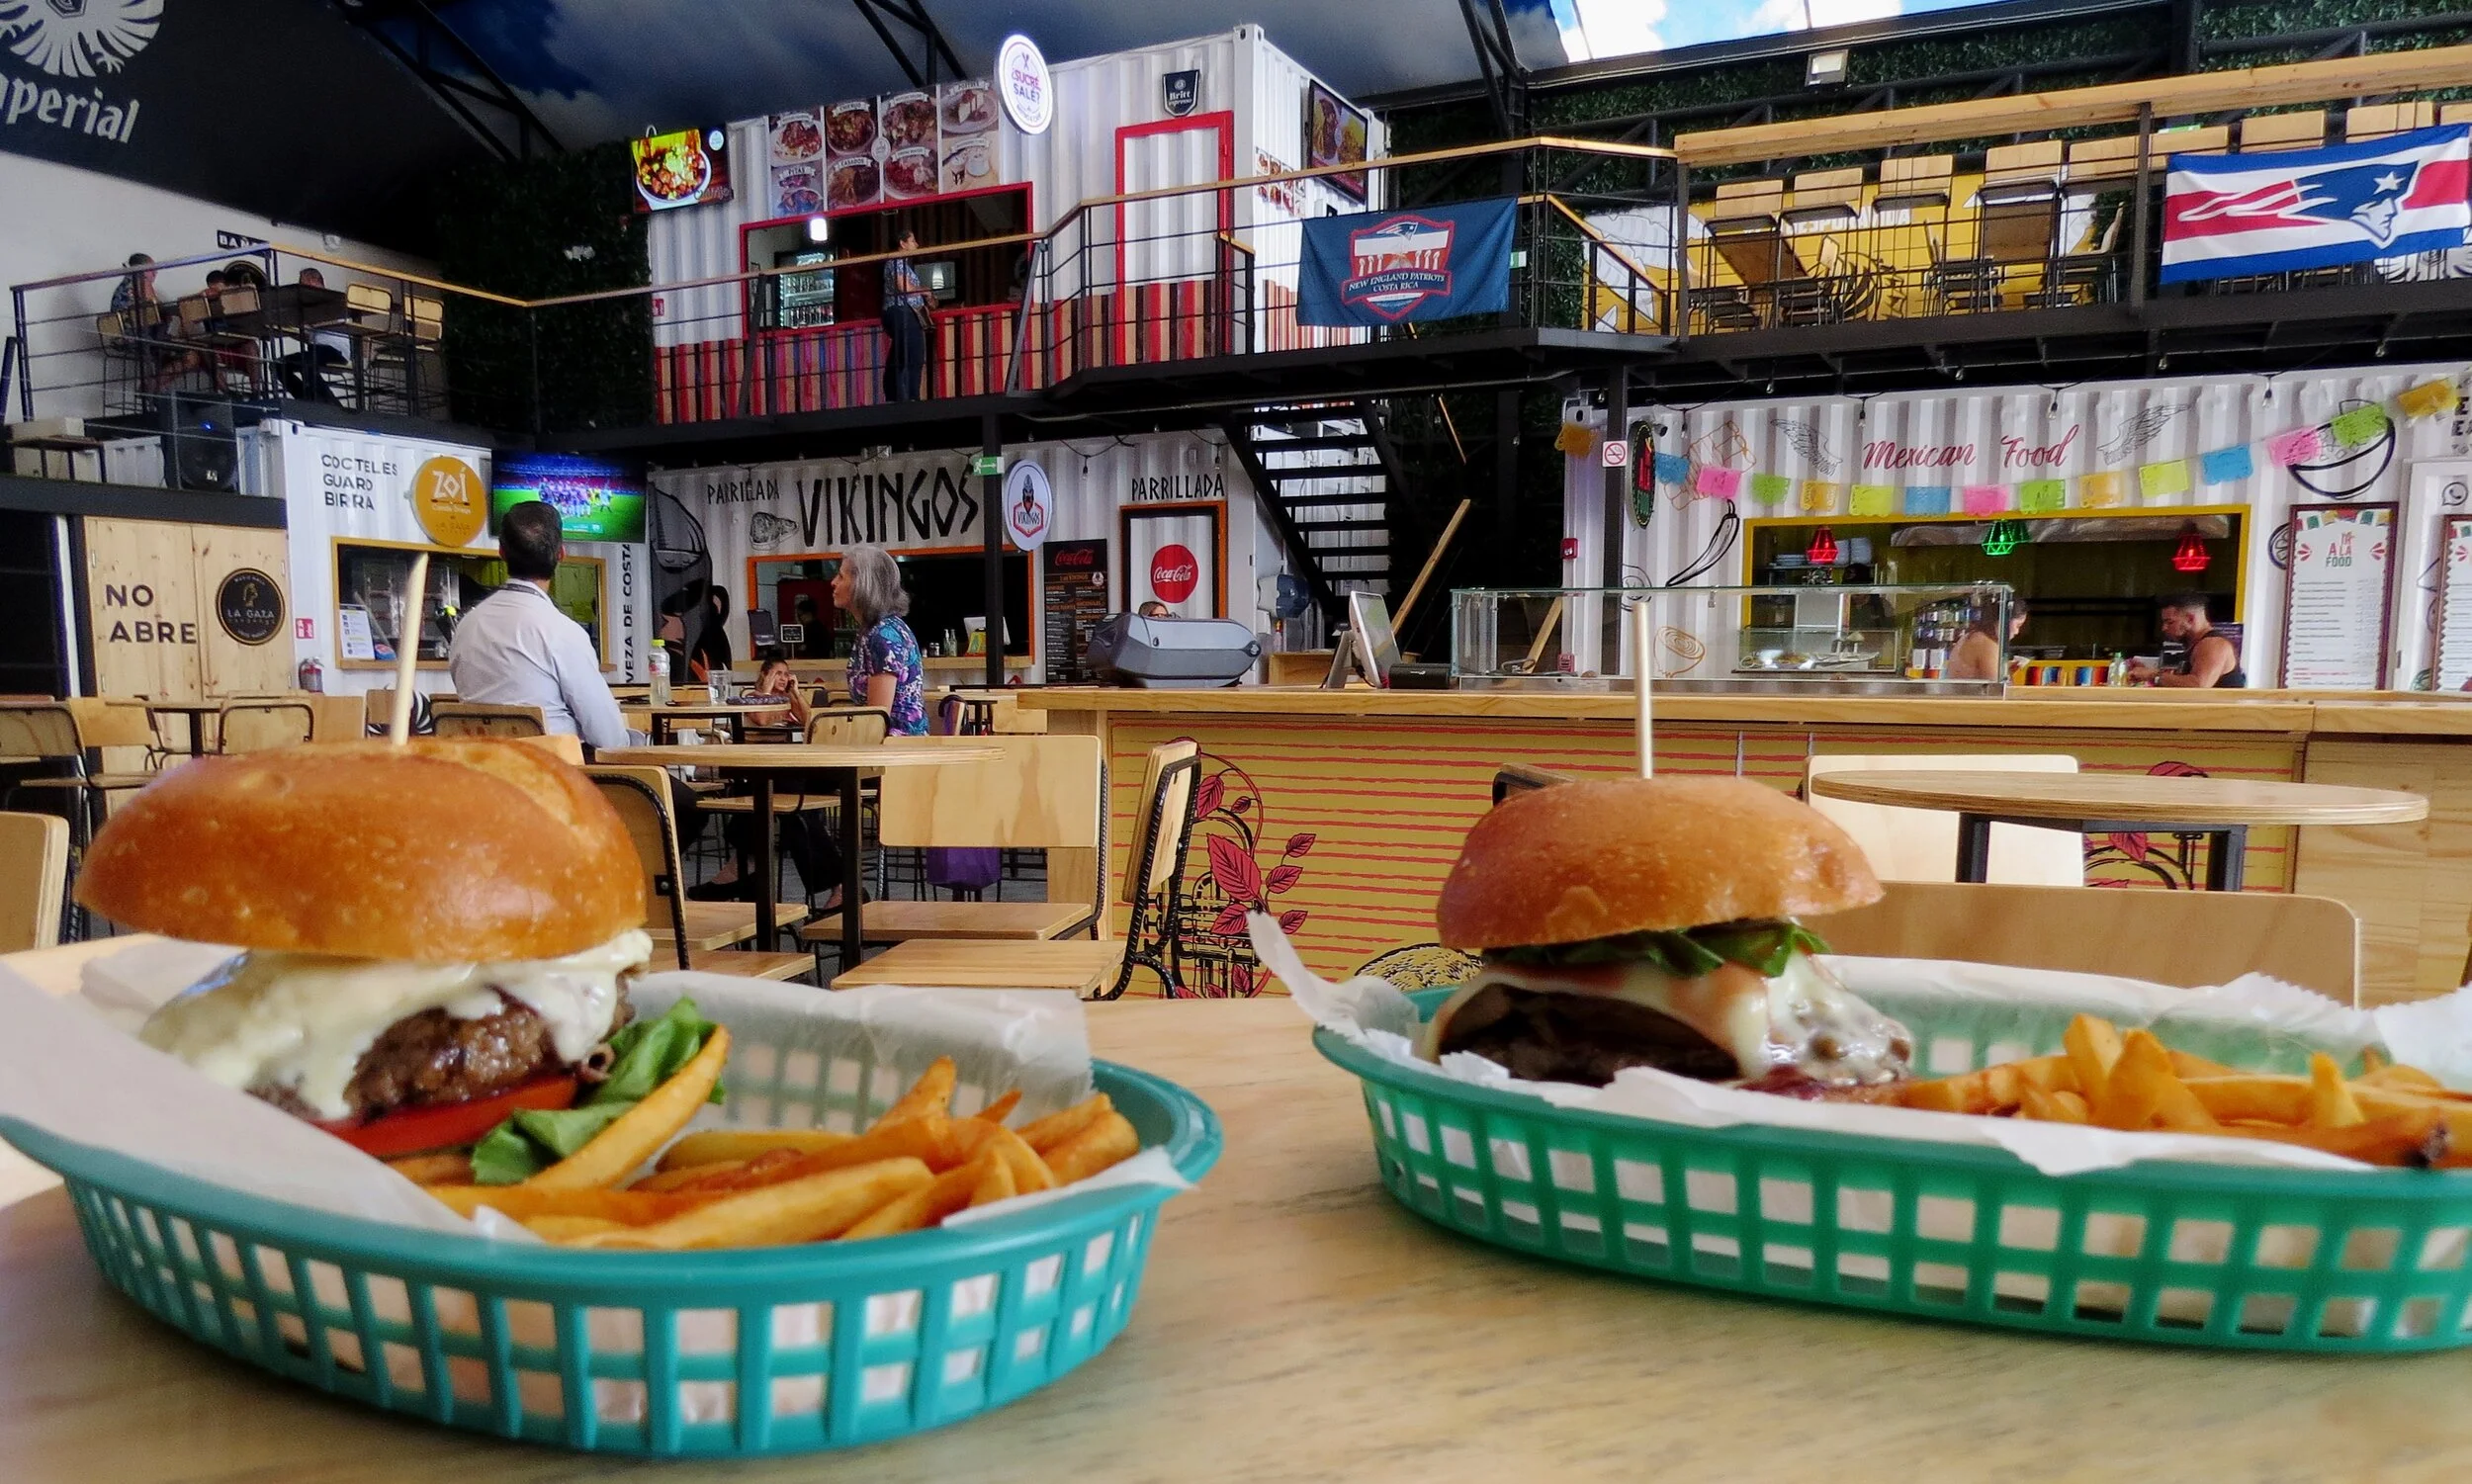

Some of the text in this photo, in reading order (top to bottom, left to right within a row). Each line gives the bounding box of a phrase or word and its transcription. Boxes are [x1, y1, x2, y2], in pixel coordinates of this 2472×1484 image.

[1169, 90, 1191, 101] Britt
[1349, 272, 1446, 292] NEW ENGLAND PATRIOTS
[1372, 284, 1399, 293] COSTA
[1863, 424, 2079, 471] Mexican Food
[321, 454, 397, 477] COCTELES
[322, 474, 373, 491] GUARO
[1131, 473, 1225, 501] PARRILLADA
[324, 491, 375, 511] BIRRA
[797, 466, 979, 548] VIKINGOS
[622, 544, 632, 596] COSTA
[2325, 557, 2352, 567] FOOD
[1153, 565, 1193, 583] Coca-Cola
[106, 584, 154, 608] NO
[227, 609, 241, 618] LA
[623, 604, 633, 627] DE
[109, 620, 197, 644] ABRE
